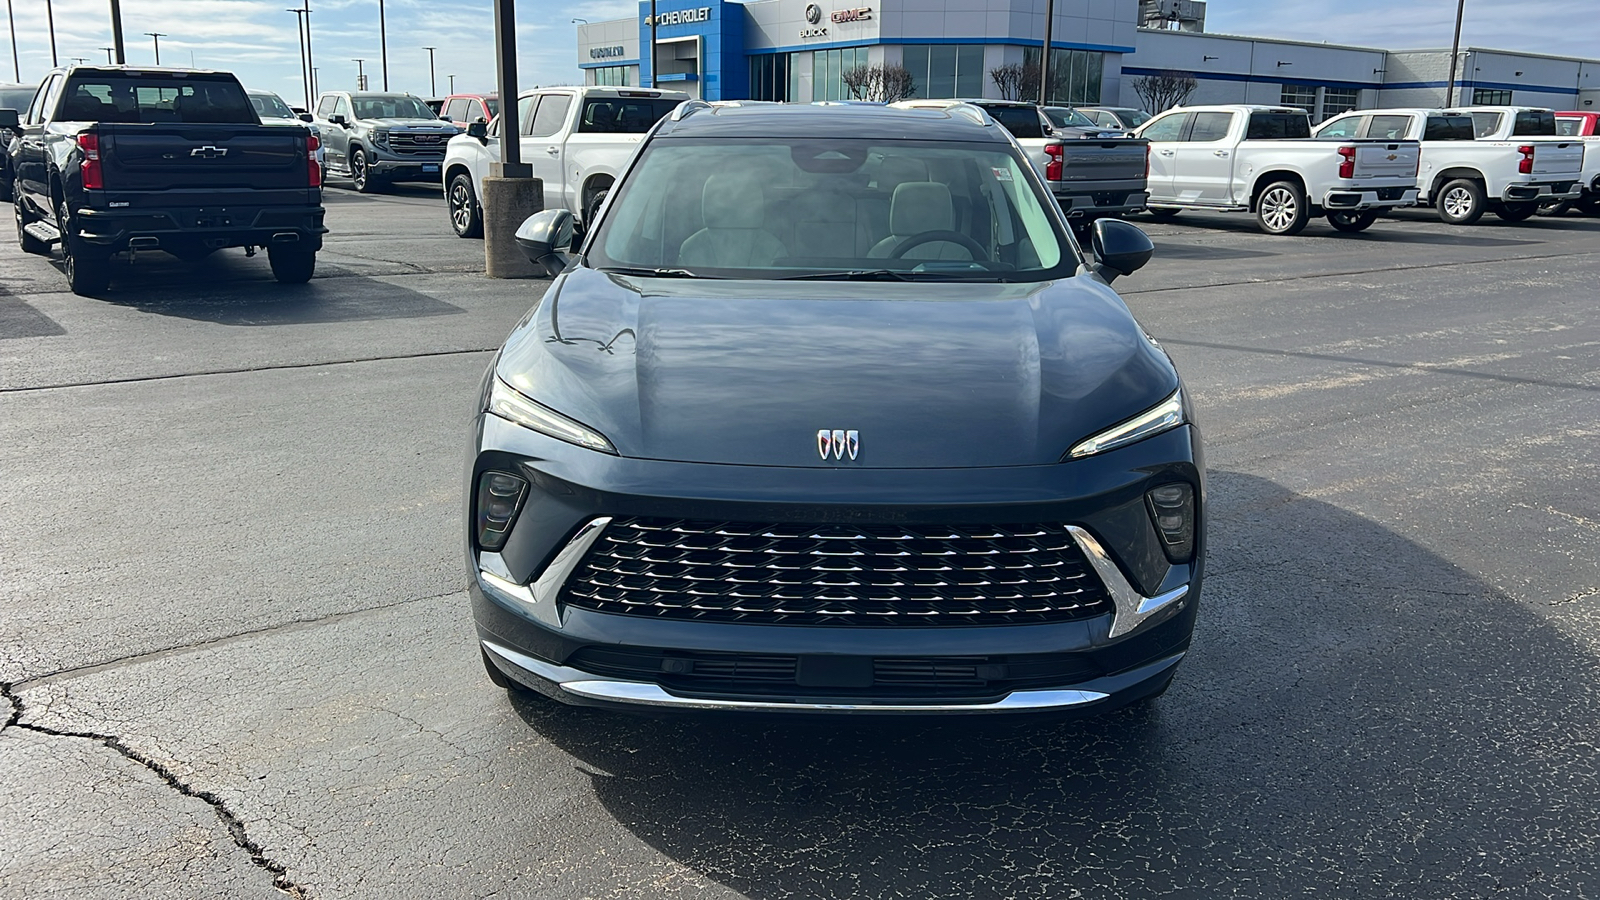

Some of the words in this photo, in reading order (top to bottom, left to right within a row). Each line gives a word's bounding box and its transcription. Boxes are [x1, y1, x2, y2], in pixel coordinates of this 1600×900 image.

[661, 7, 710, 25] CHEVROLET
[831, 7, 870, 23] GMC
[799, 28, 826, 38] BUICK
